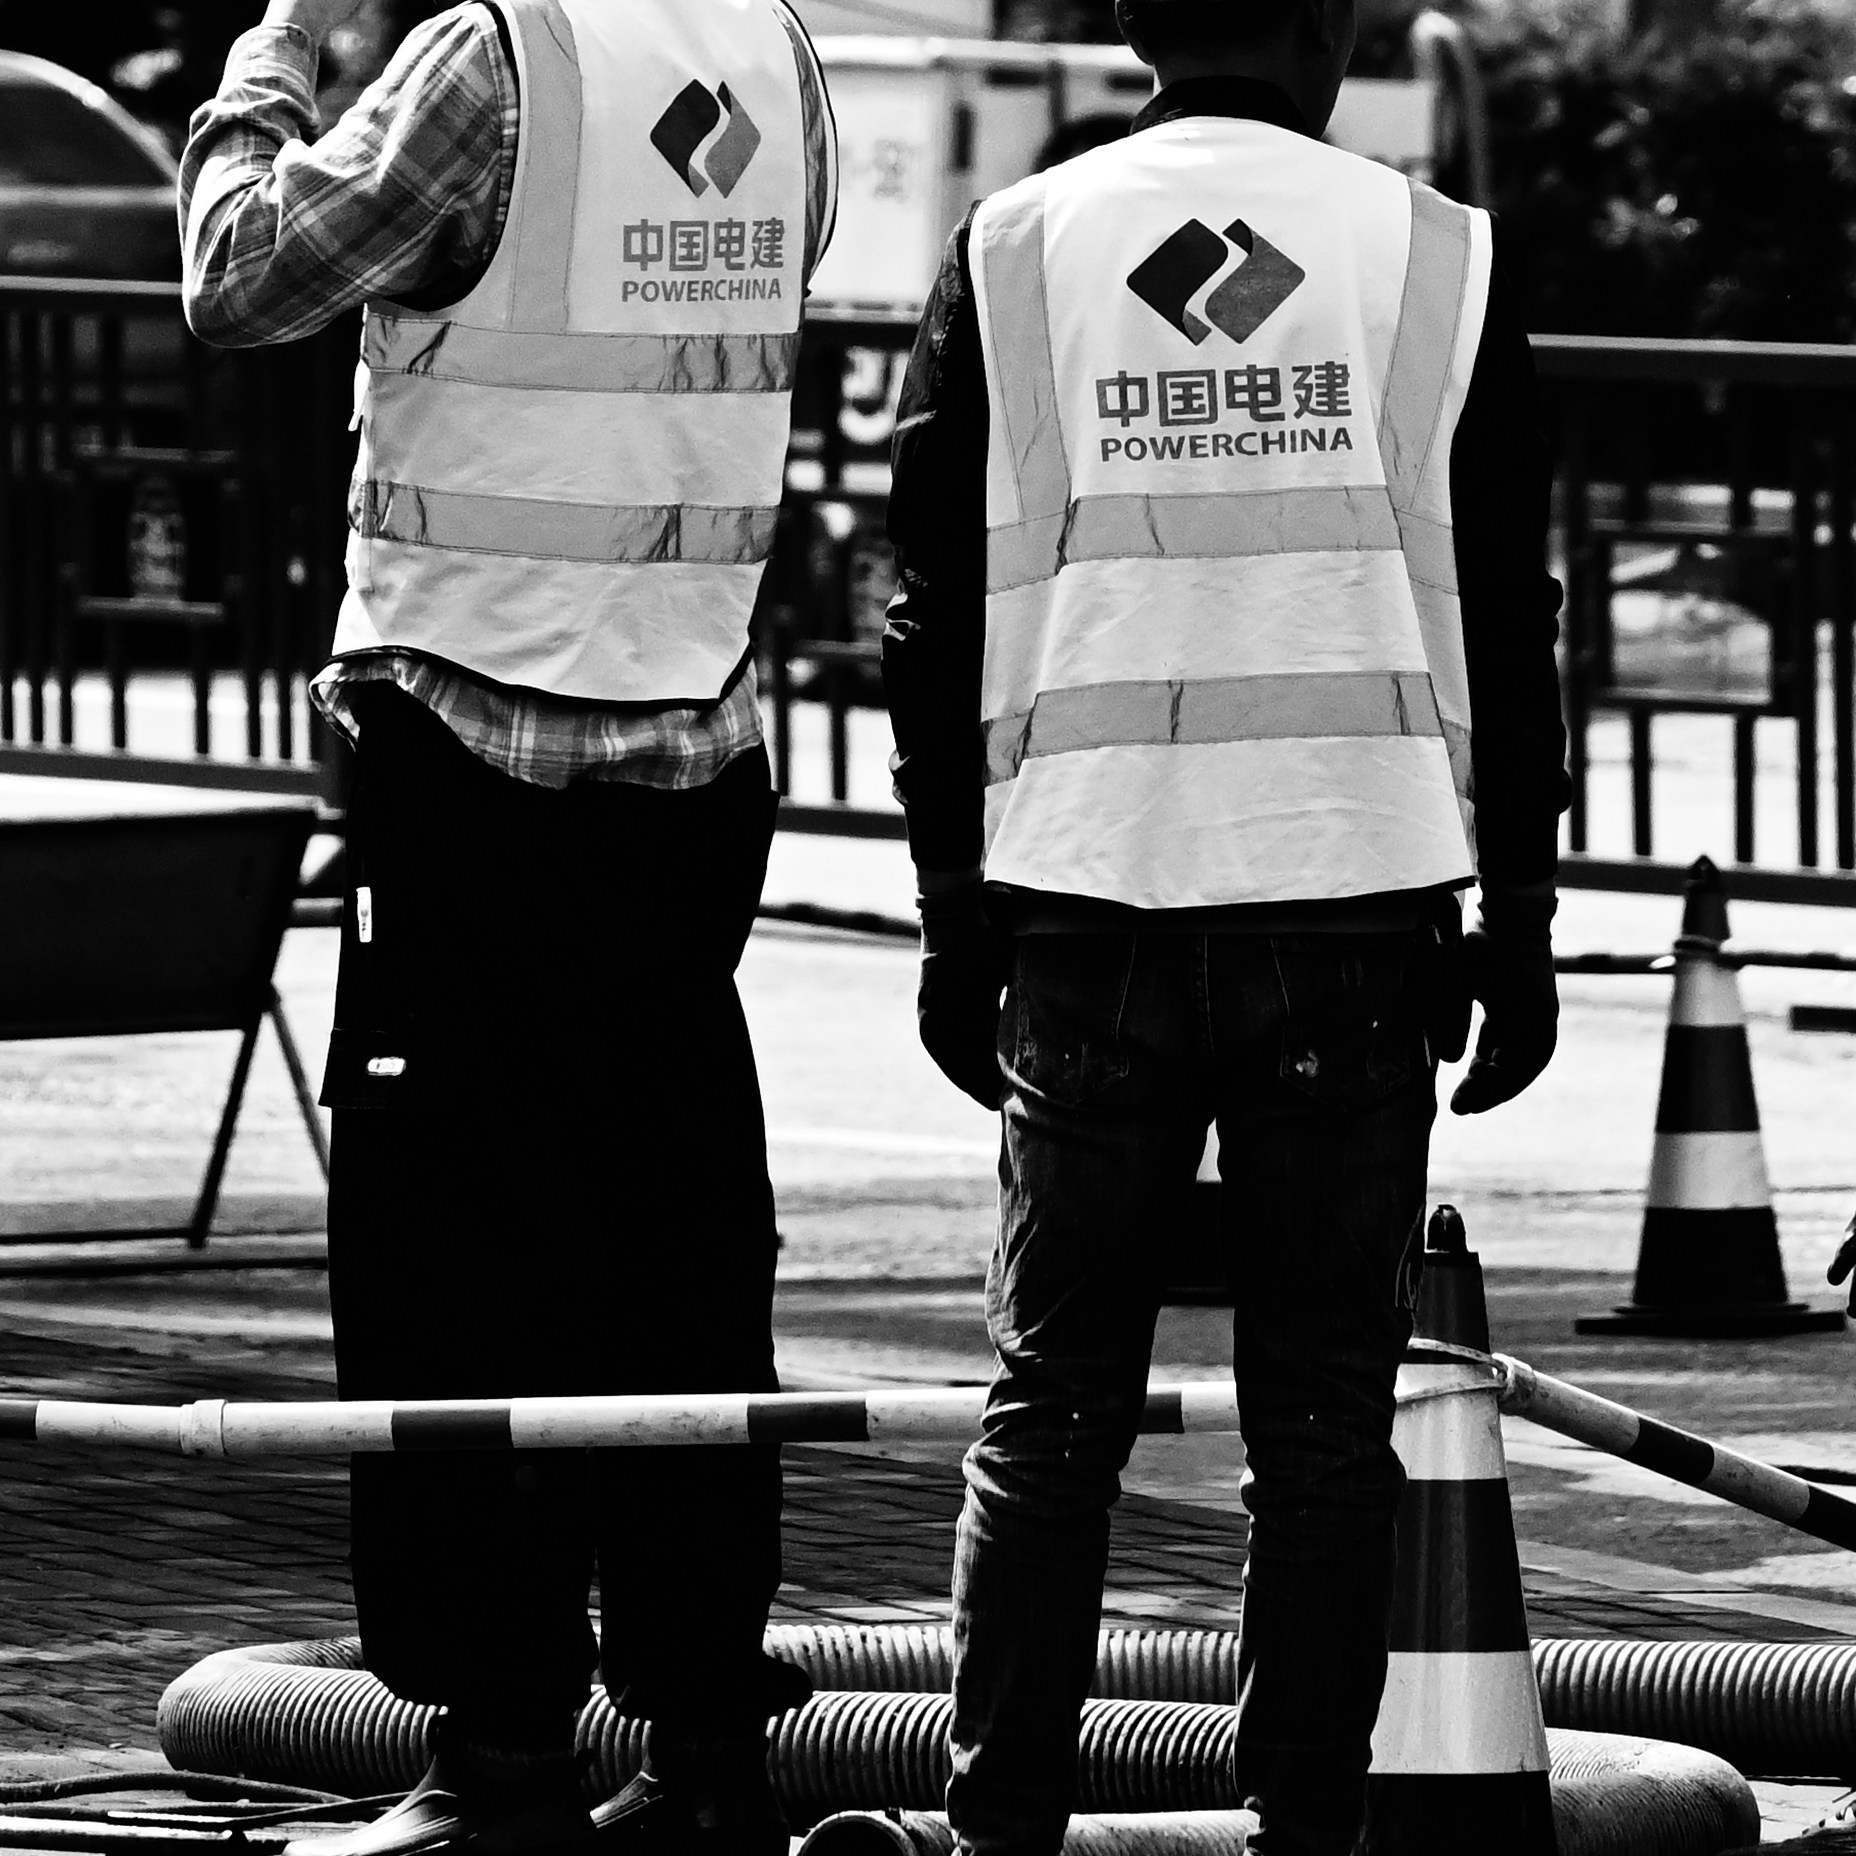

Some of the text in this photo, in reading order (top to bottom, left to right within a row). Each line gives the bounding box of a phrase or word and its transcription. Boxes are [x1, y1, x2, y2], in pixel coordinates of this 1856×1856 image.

[622, 217, 785, 272] 中国电建
[621, 278, 782, 303] POWERCHINA
[1095, 361, 1353, 428] 中国电建
[1100, 427, 1353, 462] POWERCHINA
